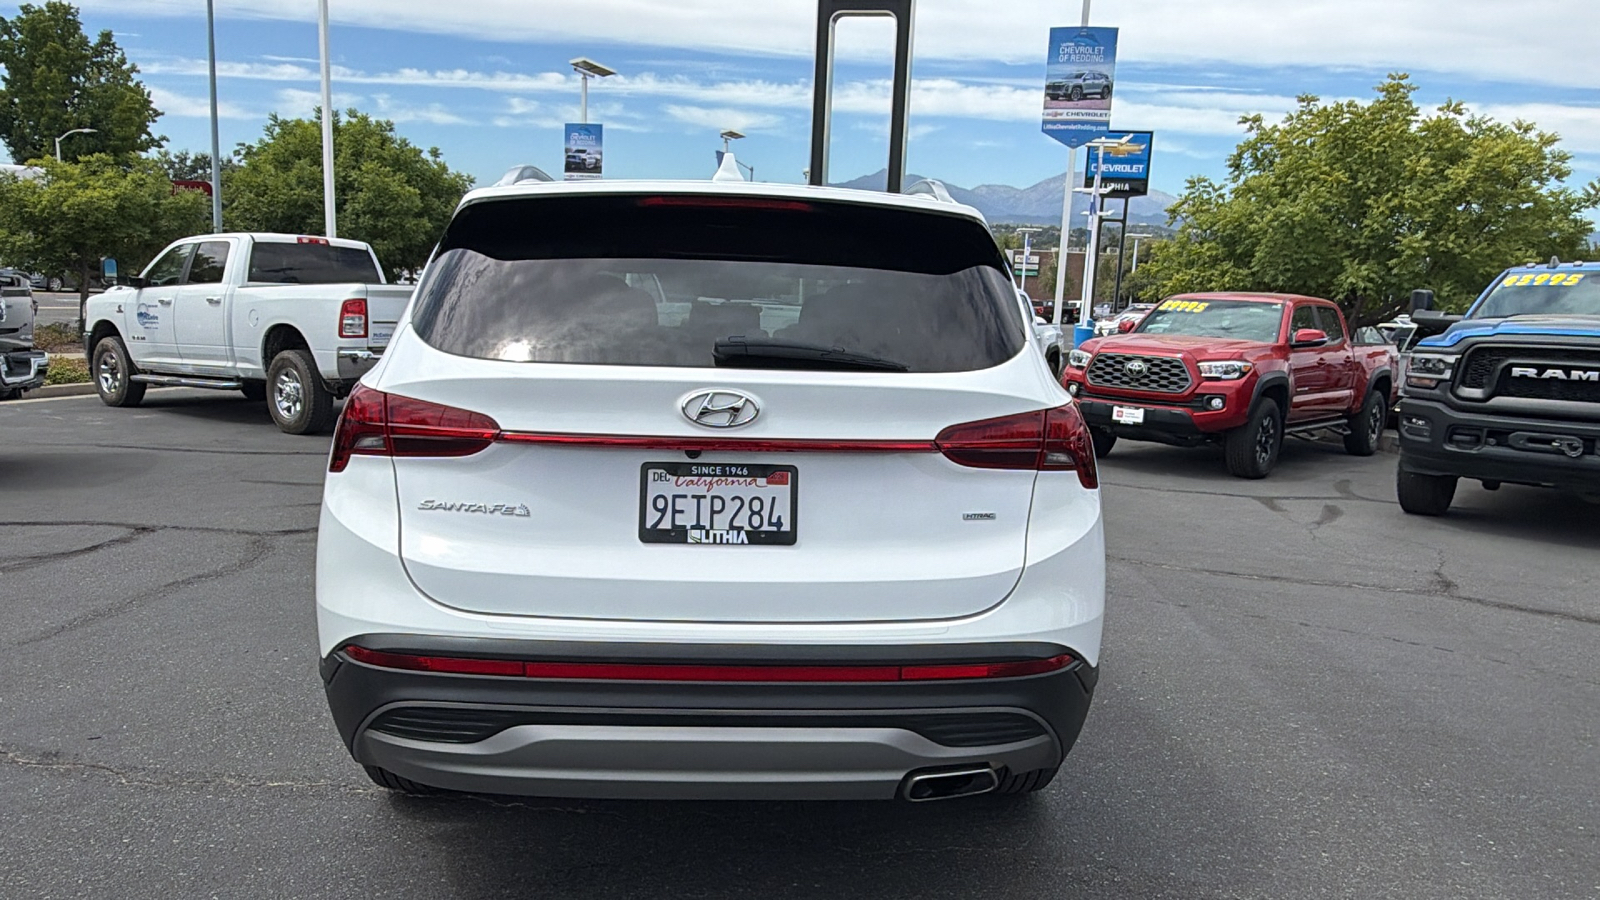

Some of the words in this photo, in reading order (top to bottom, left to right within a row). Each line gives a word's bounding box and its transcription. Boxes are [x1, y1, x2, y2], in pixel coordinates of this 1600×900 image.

[1060, 46, 1104, 55] CHEVROLET
[1059, 54, 1069, 62] OF
[1070, 54, 1104, 62] REDDING
[1511, 367, 1600, 381] RAM
[691, 466, 722, 475] SINCE
[725, 467, 748, 476] 1946
[653, 472, 670, 482] DEC
[674, 476, 768, 493] California
[650, 493, 784, 532] 9EIP284
[965, 512, 994, 520] HTRAC
[701, 530, 749, 544] LITHIA
